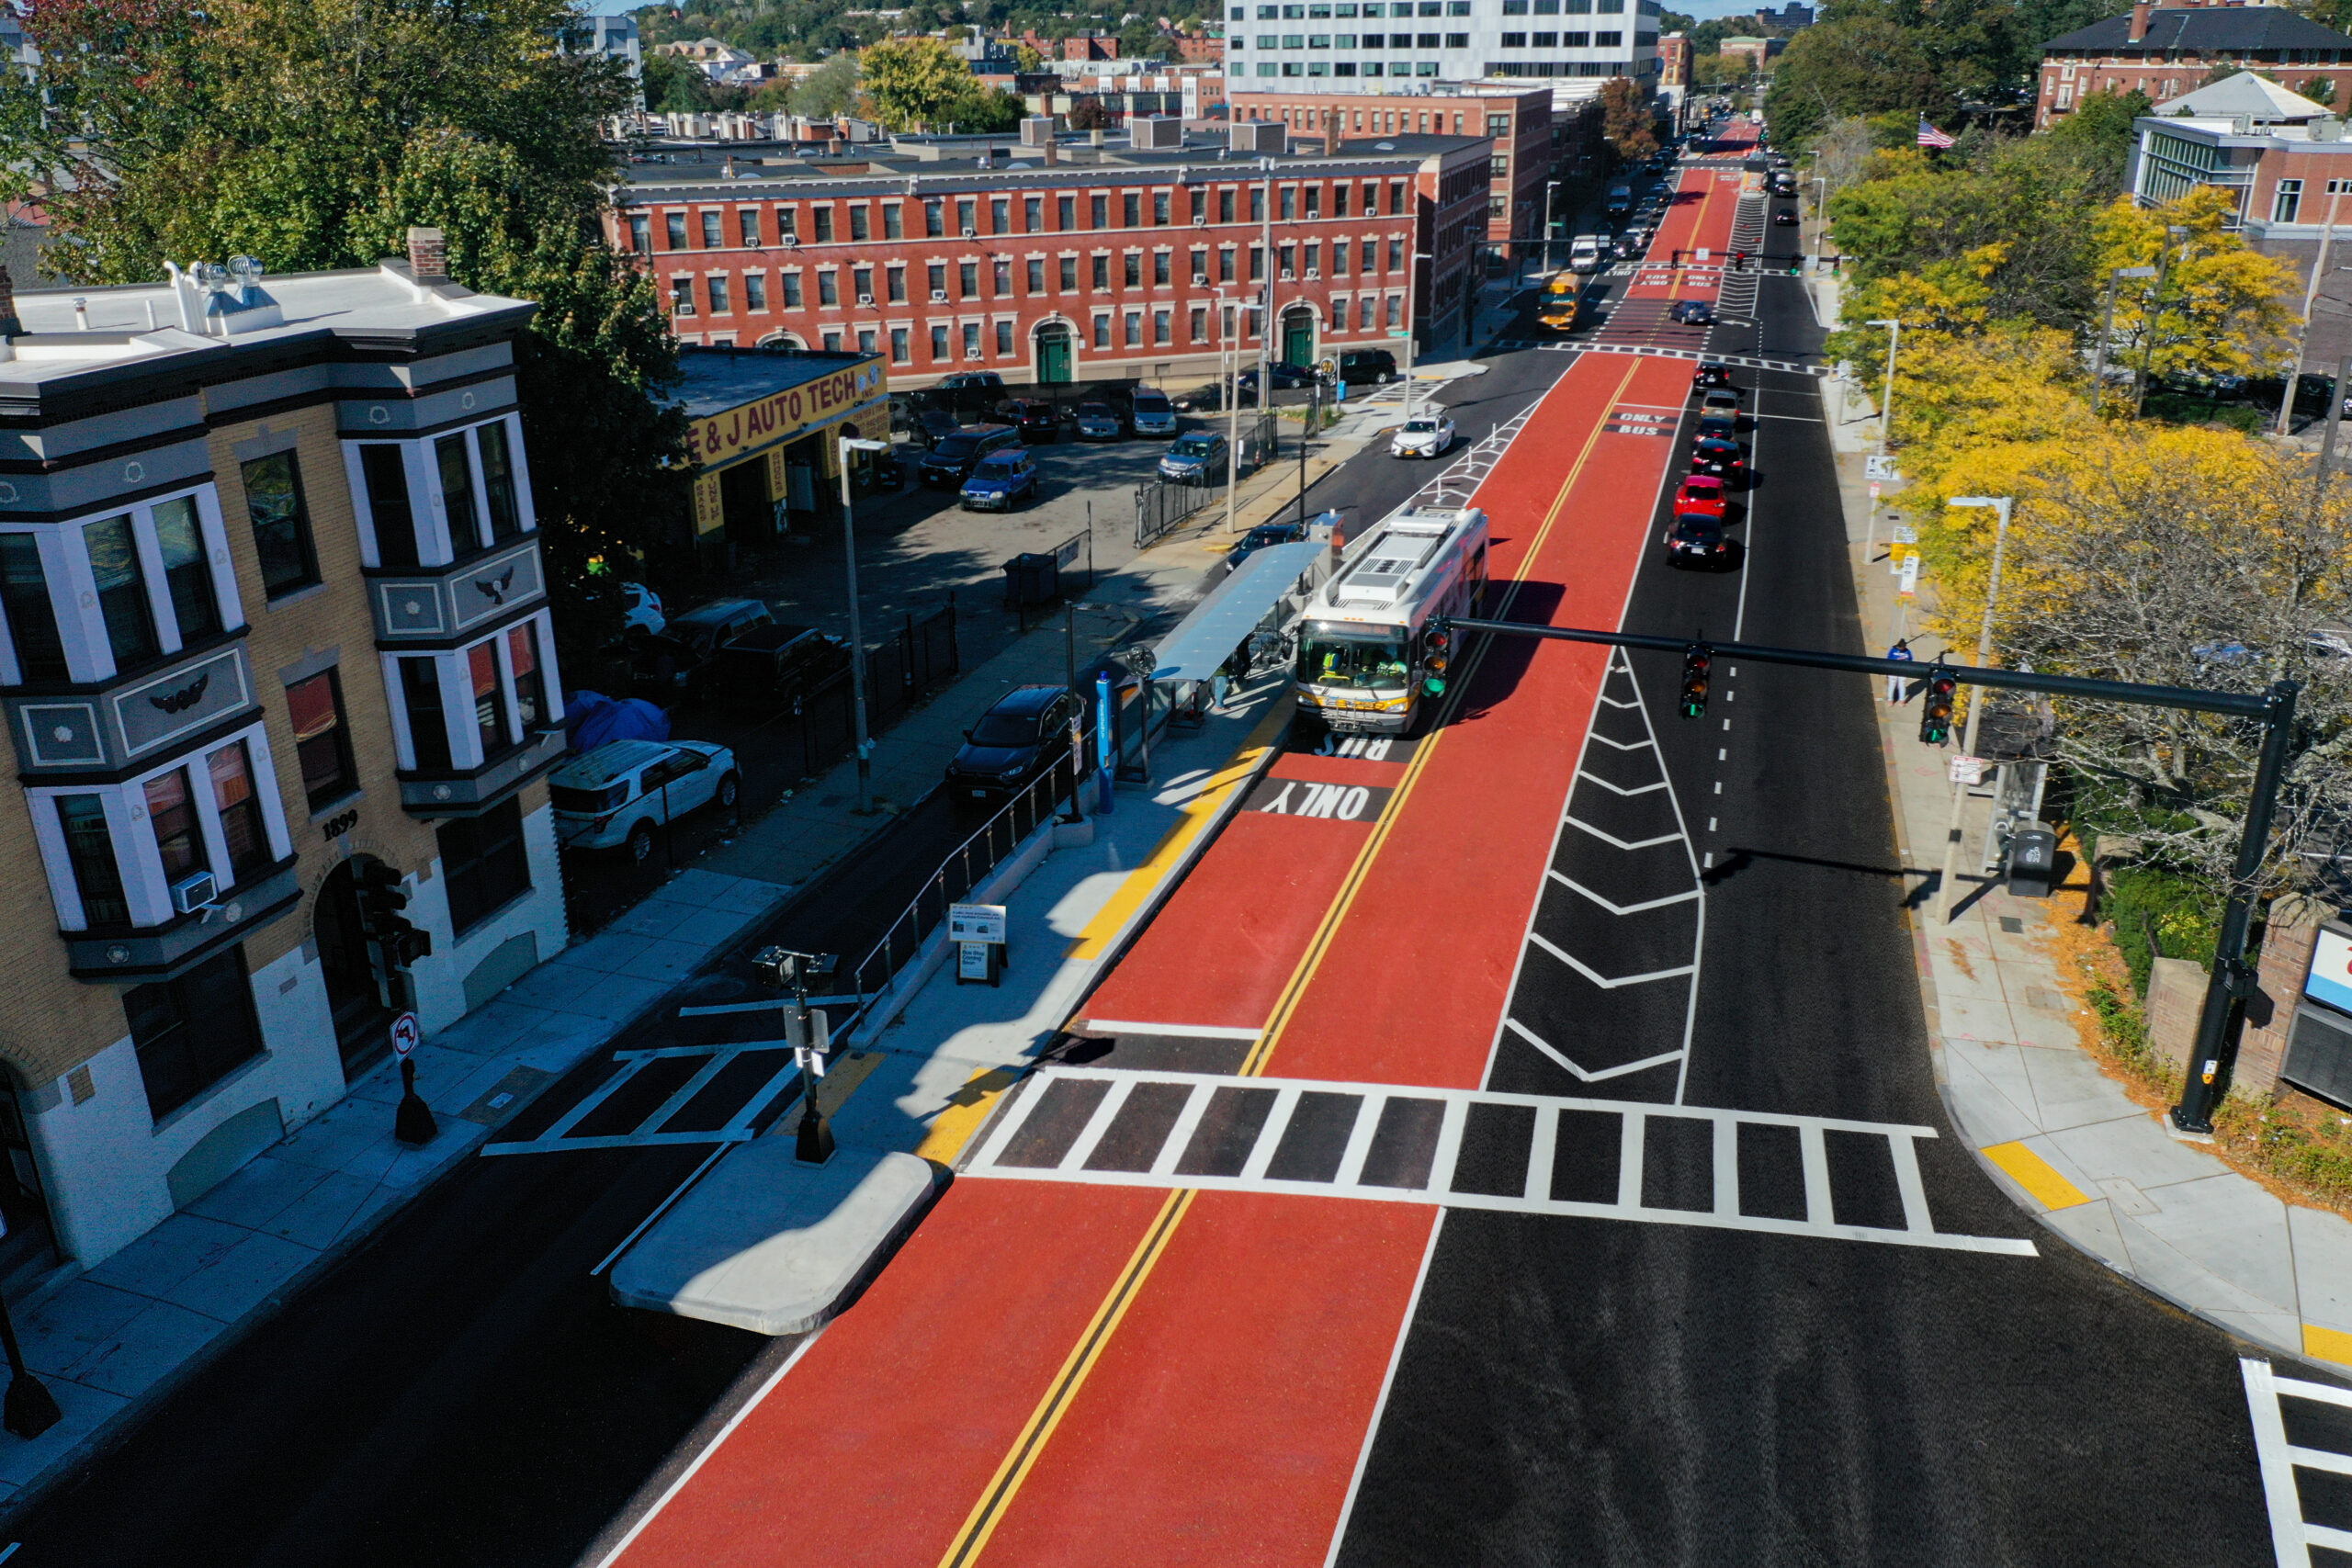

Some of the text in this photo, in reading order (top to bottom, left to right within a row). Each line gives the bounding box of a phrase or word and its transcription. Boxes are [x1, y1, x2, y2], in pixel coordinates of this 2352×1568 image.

[706, 421, 722, 455] &
[726, 413, 741, 446] J
[747, 391, 802, 439] AUTO
[807, 370, 856, 412] TECH
[1620, 412, 1667, 423] ONLY
[1618, 424, 1659, 435] BUS
[1261, 781, 1370, 820] ONLY
[322, 809, 357, 842] 1899
